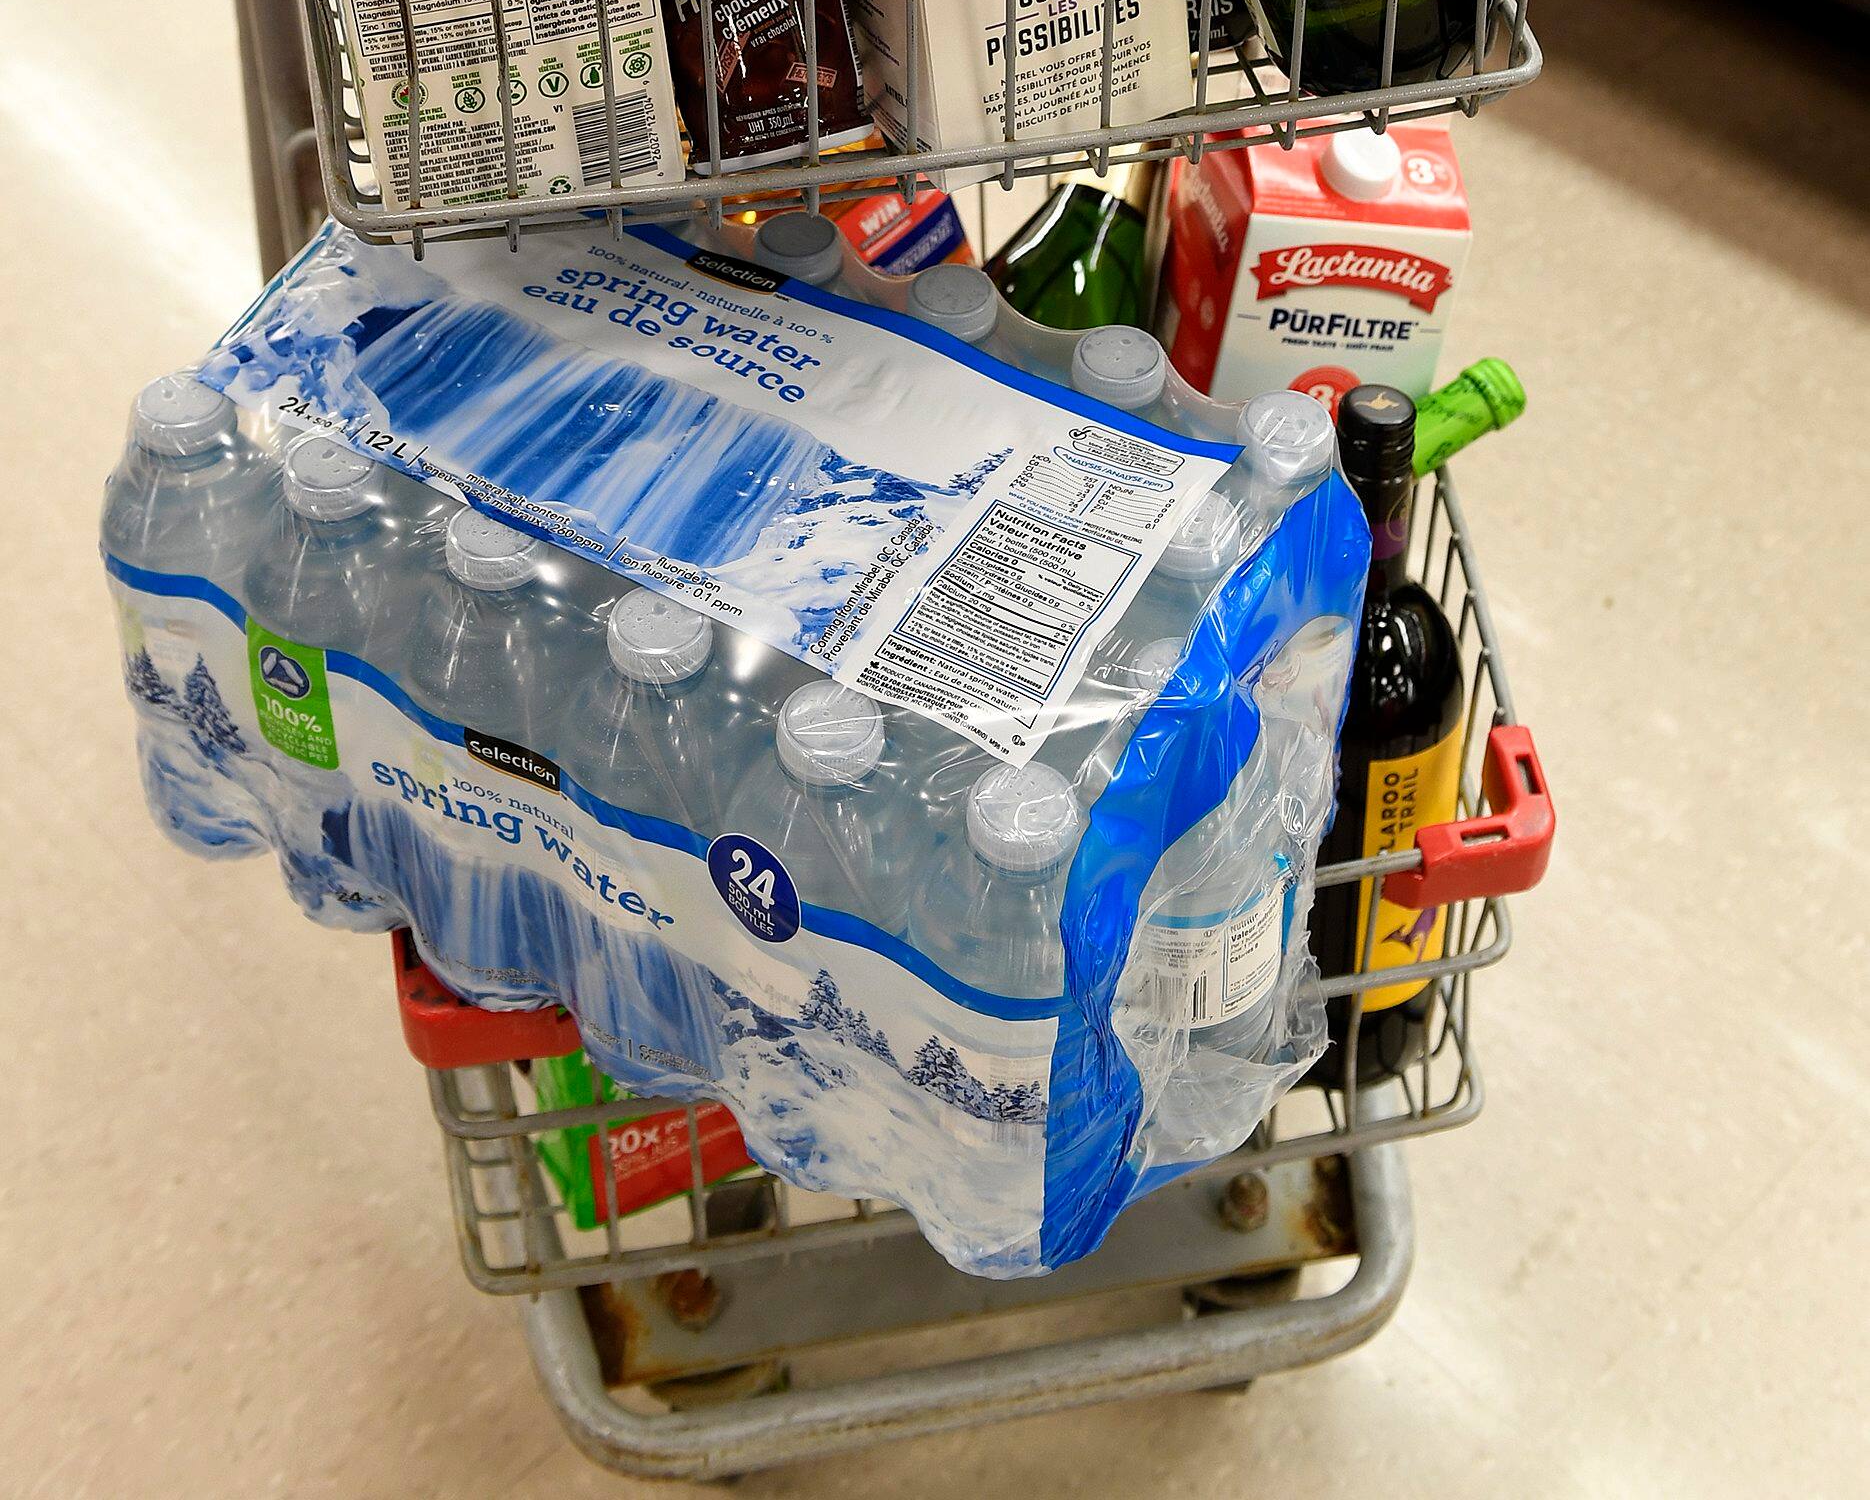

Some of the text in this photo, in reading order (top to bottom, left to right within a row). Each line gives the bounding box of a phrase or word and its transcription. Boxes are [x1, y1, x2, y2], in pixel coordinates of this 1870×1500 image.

[751, 33, 767, 48] vrai
[1066, 41, 1151, 78] POUR VOS
[1039, 50, 1097, 74] VOUS OFFRE
[1038, 91, 1080, 112] JOURNÉE
[1050, 79, 1078, 95] LATTÉ
[748, 120, 765, 134] UHT
[1017, 112, 1058, 129] BISCUITS
[1269, 247, 1435, 293] Lactantia
[587, 245, 817, 339] 100% natural naturelle 100
[556, 267, 821, 372] spring water
[522, 285, 806, 404] eau de source
[278, 396, 394, 452] 24 12
[465, 472, 571, 526] mineral content
[574, 534, 604, 553] ppm
[989, 518, 1083, 561] Valeur nutritive
[994, 509, 1087, 551] Nutrition Facts
[1005, 536, 1029, 550] bottle
[656, 556, 701, 585] fluoride
[969, 541, 1010, 564] Calories
[1004, 545, 1038, 562] bouteille
[640, 559, 743, 617] fluorure ppm
[810, 518, 920, 655] Coming from Mirabel, Canada
[823, 524, 934, 662] Provenant Mirabel, Canada
[881, 648, 928, 673] Ingrédient
[887, 639, 994, 691] Ingredient: Natural spring
[259, 692, 323, 734] 100%
[452, 777, 574, 841] 100% natural
[1400, 768, 1418, 832] TRAIL
[370, 761, 676, 931] spring water
[729, 849, 775, 910] 24
[728, 882, 775, 926] 500 mL
[728, 894, 774, 936] BOTTLES
